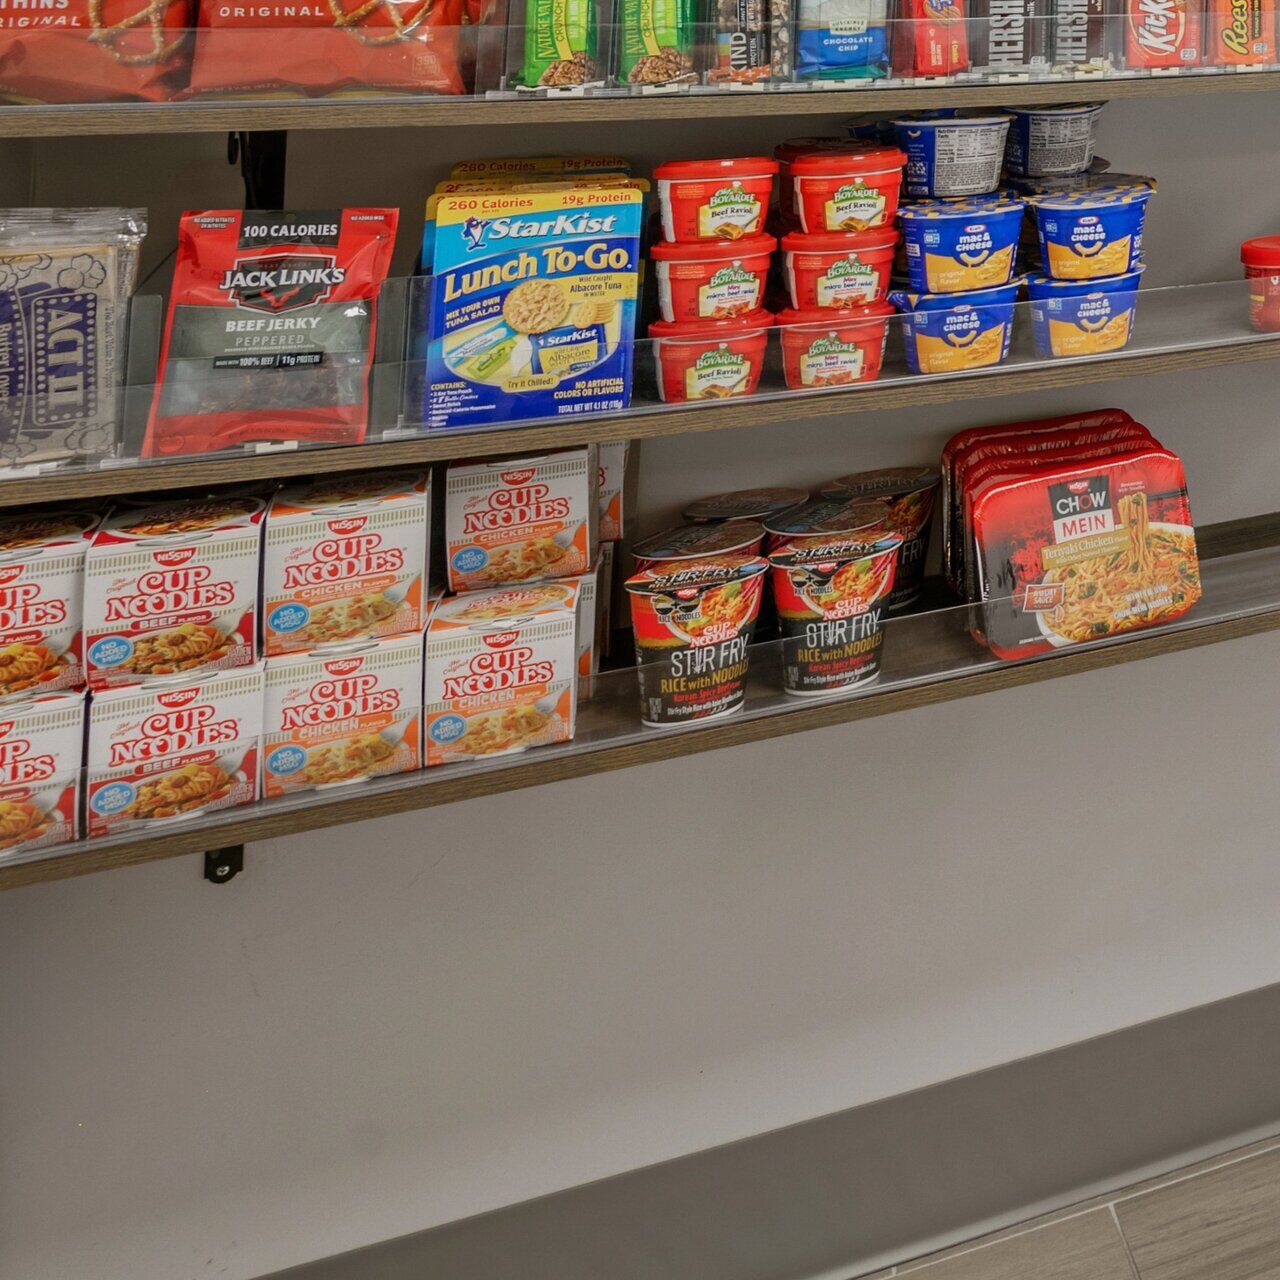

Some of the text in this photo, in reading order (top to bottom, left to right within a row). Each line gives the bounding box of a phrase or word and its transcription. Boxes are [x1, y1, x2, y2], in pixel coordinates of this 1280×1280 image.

[219, 5, 325, 18] ORIGINAL
[448, 192, 631, 211] 260 Calories 19g Protein
[836, 201, 854, 212] Beef
[711, 207, 730, 218] Beef
[244, 224, 338, 237] 100 CALORIES
[488, 211, 618, 241] StarKist
[1074, 225, 1095, 234] mac
[959, 234, 982, 243] mac
[220, 266, 345, 290] JACK LINK'S
[443, 242, 629, 303] Lunch To-Go
[570, 282, 602, 293] Albacore
[462, 301, 482, 315] YOUR
[470, 305, 500, 320] SALAD
[1080, 301, 1101, 310] mac
[226, 317, 321, 332] BEEF JERKY
[946, 314, 970, 323] mac
[235, 334, 305, 347] PEPPERED
[547, 329, 598, 346] StarKist
[239, 355, 260, 366] 100%
[697, 369, 716, 380] Beef
[554, 386, 624, 400] COLORS OR FLAVORS
[488, 483, 549, 511] CUP
[1056, 490, 1107, 516] CHOW
[464, 498, 570, 535] NOODLES
[1062, 514, 1106, 538] MEIN
[480, 527, 534, 543] CHICKEN
[313, 533, 381, 562] CUP
[1043, 535, 1115, 561] Teriyaki Chicken
[284, 548, 404, 590] NOODLES
[137, 566, 211, 594] CUP
[301, 580, 363, 598] CHICKEN
[106, 582, 235, 622] NOODLES
[835, 596, 862, 611] CUP
[823, 602, 870, 622] NOODLES
[139, 617, 177, 630] BEEF
[850, 608, 882, 639] FRY
[690, 628, 739, 648] NOODLES
[95, 646, 128, 660] ADDED
[470, 646, 533, 676] CUP
[671, 634, 749, 678] STIR FRY
[798, 646, 843, 664] RICE with
[310, 674, 378, 704] CUP
[442, 661, 554, 701] NOODLES
[661, 674, 711, 693] RICE with
[281, 688, 401, 732] NOODLES
[459, 691, 516, 711] CHICKEN
[142, 705, 215, 737] CUP
[299, 720, 360, 740] CHICKEN
[109, 718, 239, 767] NOODLES
[143, 756, 180, 773] BEEF
[98, 791, 129, 807] ADDED
